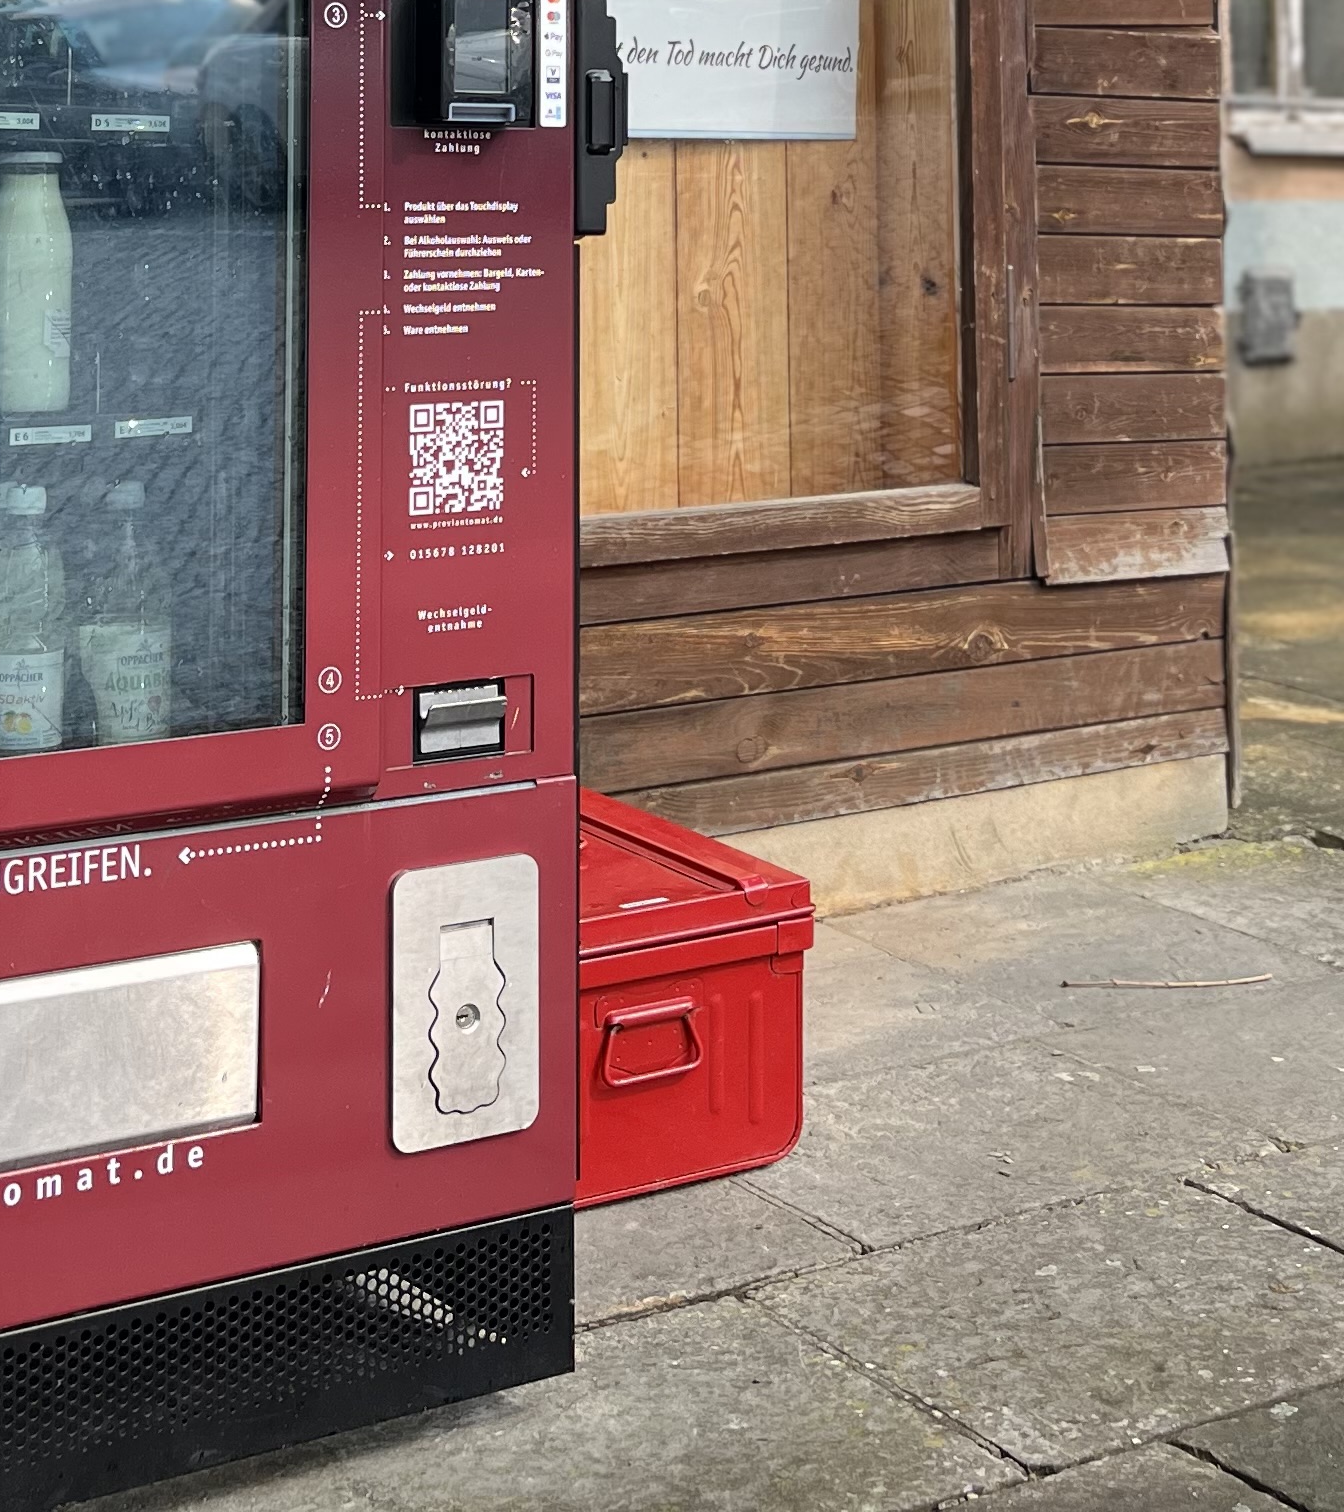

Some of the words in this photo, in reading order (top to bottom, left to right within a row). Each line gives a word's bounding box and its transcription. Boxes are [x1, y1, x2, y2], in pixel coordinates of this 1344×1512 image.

[550, 32, 563, 42] Pay
[626, 36, 659, 65] den
[667, 38, 695, 66] Tod
[698, 41, 753, 69] macht
[758, 43, 796, 72] Dich
[799, 46, 854, 80] gesund.
[545, 92, 562, 100] VISA
[424, 129, 492, 140] kontaktlose
[434, 142, 480, 155] Zahlung
[404, 202, 436, 212] Produkt
[436, 201, 454, 211] über
[455, 201, 469, 211] das
[470, 200, 518, 213] Touchdisplay
[404, 214, 446, 224] auswählen
[404, 235, 418, 245] Bei
[418, 235, 481, 245] Alkoholauswahl:
[482, 234, 513, 245] Ausweis
[514, 235, 532, 244] oder
[404, 248, 454, 258] Führerschein
[455, 247, 502, 258] durchziehen
[403, 269, 435, 281] Zahlung
[436, 268, 482, 279] vornehmen:
[483, 268, 514, 280] Bargeld,
[515, 267, 545, 278] Karten-
[403, 283, 421, 292] oder
[422, 282, 468, 292] kontaktlose
[469, 281, 500, 292] Zahlung
[403, 303, 452, 315] Wechselgeld
[452, 302, 496, 313] entnehmen
[403, 325, 423, 335] Ware
[424, 324, 469, 335] entnehmen
[404, 378, 512, 393] Funktionsstörung?
[410, 515, 503, 530] www.proviantomat.de
[409, 546, 455, 560] 015678
[461, 542, 505, 556] 128201
[417, 604, 492, 622] Wechselgeld-
[427, 619, 483, 634] entnahme
